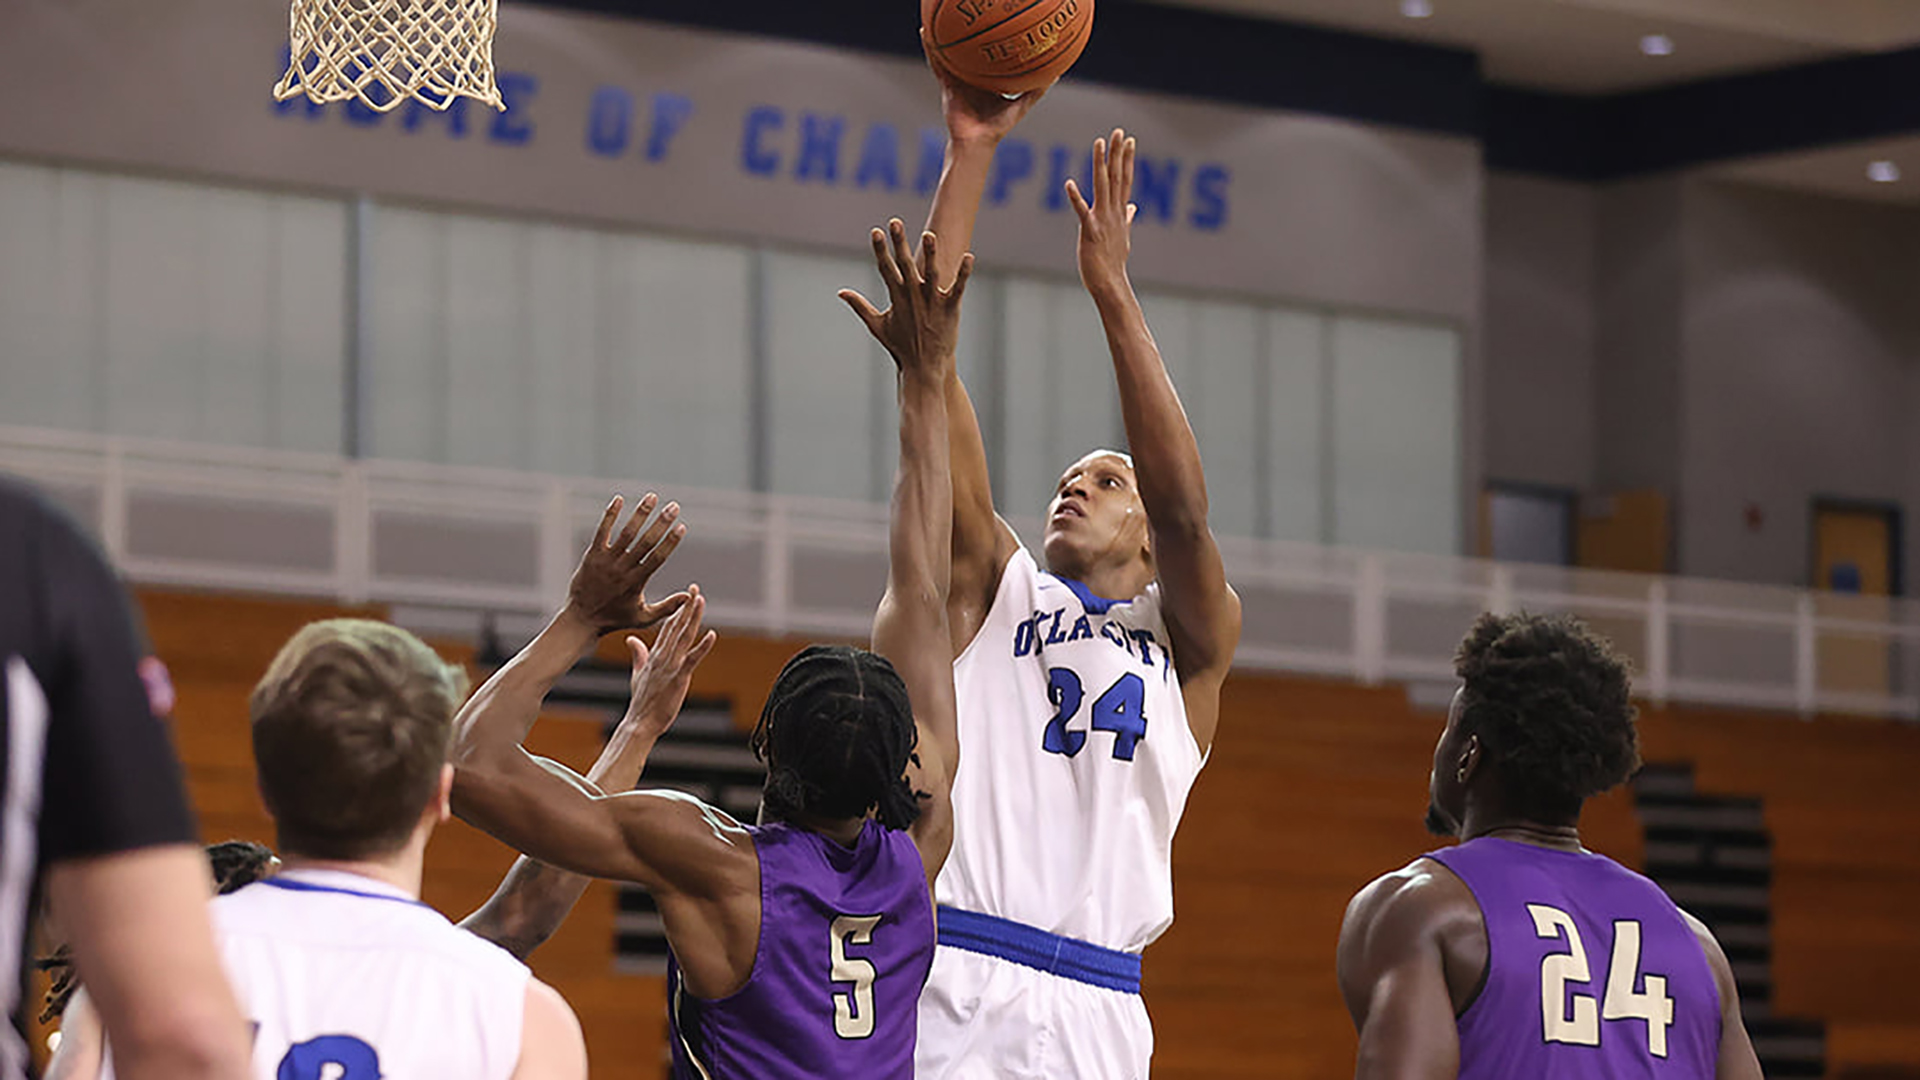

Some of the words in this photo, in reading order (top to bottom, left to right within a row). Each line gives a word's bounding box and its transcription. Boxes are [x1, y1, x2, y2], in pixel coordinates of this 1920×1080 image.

[586, 84, 692, 163] OF
[741, 105, 1232, 230] CHAPINS
[1042, 666, 1148, 762] 24
[831, 912, 884, 1040] 5
[1525, 902, 1676, 1059] 24
